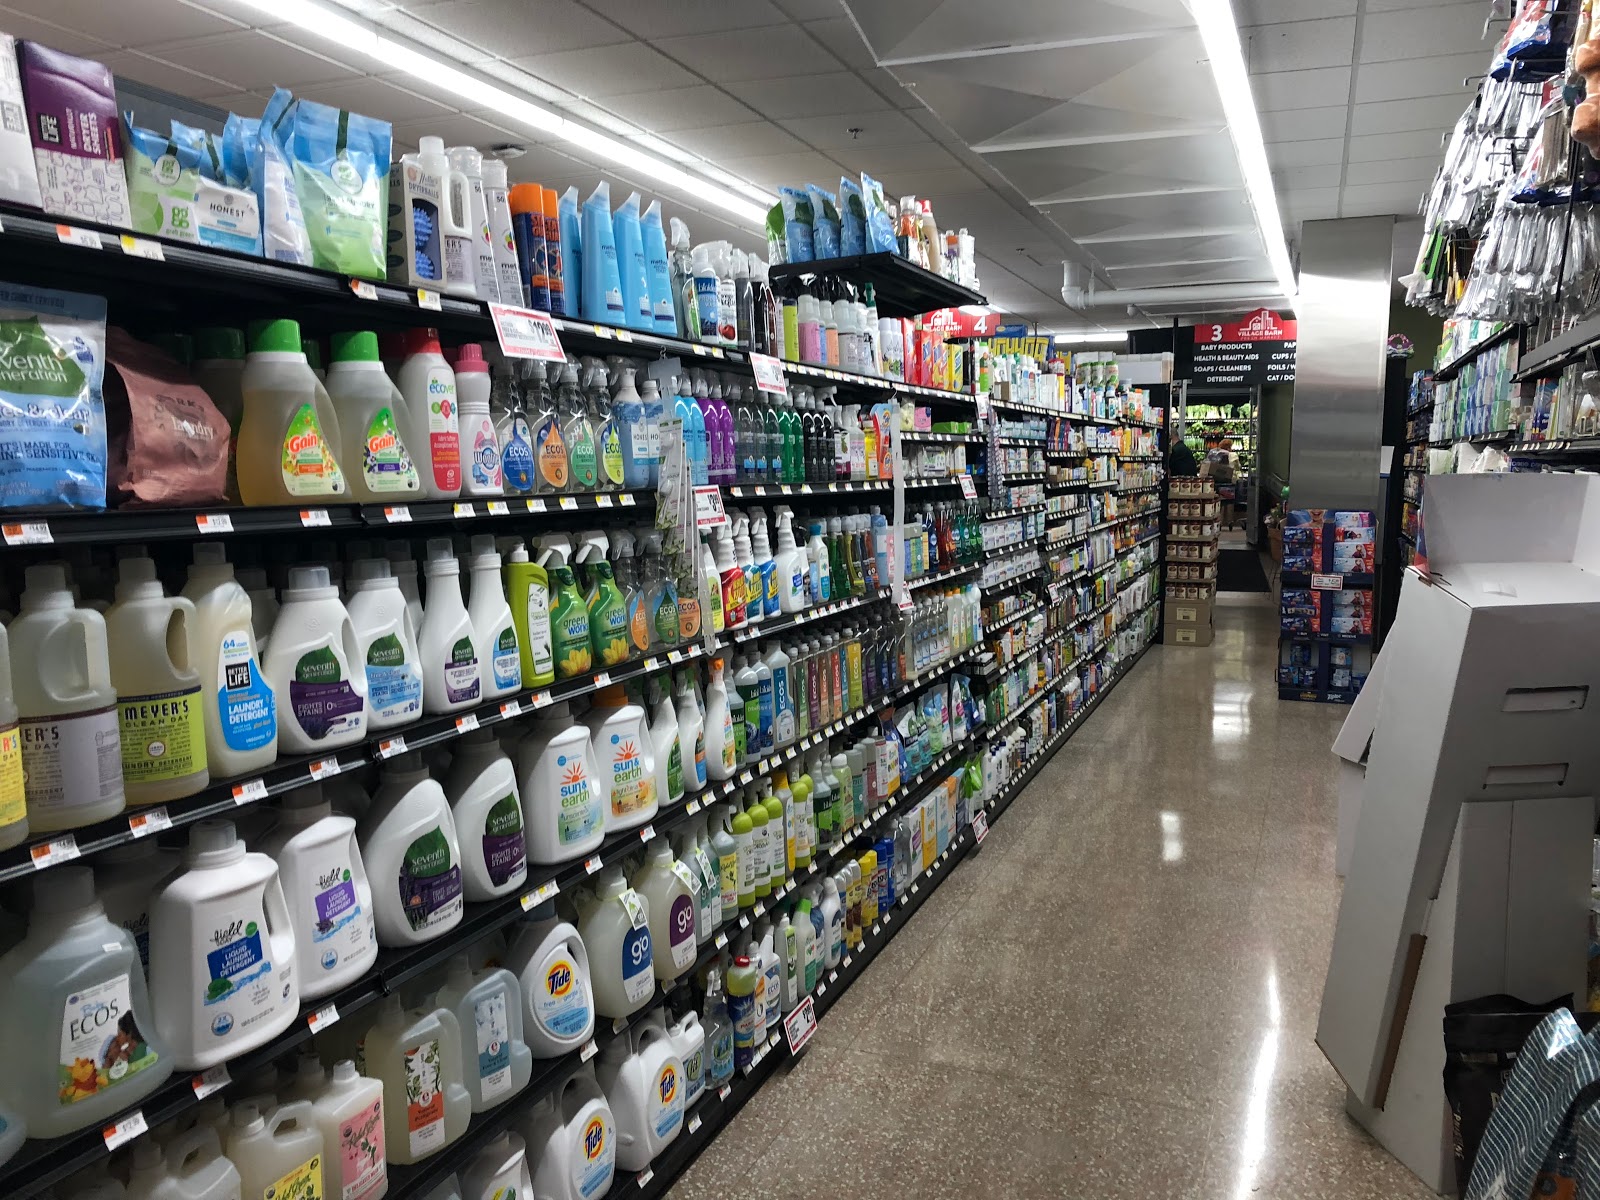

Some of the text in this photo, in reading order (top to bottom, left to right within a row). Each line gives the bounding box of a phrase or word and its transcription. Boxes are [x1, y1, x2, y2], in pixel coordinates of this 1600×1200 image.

[47, 115, 60, 143] LIFE
[80, 113, 92, 152] DRYER
[88, 112, 101, 155] SHEETS
[210, 202, 246, 218] HONEST
[974, 315, 988, 334] 4
[1211, 324, 1223, 342] 3
[1218, 342, 1253, 350] PRODUCTS
[430, 383, 455, 394] ecover
[24, 441, 70, 450] MADE FOR
[289, 433, 318, 453] Gain
[369, 434, 396, 453] Gain
[545, 445, 564, 455] ECOS
[577, 445, 593, 455] ECOS
[509, 446, 529, 457] ECOS
[659, 606, 676, 616] ECOS
[678, 603, 696, 611] ECOS
[563, 616, 586, 628] green
[224, 639, 236, 650] 64
[373, 648, 400, 658] seventh
[373, 655, 401, 664] generation
[227, 666, 248, 676] BETTER
[302, 662, 335, 672] seventh
[302, 670, 335, 679] generation
[229, 673, 249, 687] LIFE
[124, 699, 189, 720] MEYER'S
[228, 699, 264, 715] LAUNDRY
[297, 702, 322, 711] FIGHTS
[298, 708, 323, 718] STAINS
[125, 715, 189, 728] CLEAN DAY
[229, 707, 269, 725] DETERGENT
[20, 726, 60, 743] ER'S
[35, 742, 60, 750] DAY
[122, 760, 155, 770] UNDRY
[613, 758, 640, 773] sun &
[614, 766, 642, 783] earth
[560, 780, 587, 797] sun &
[561, 790, 590, 808] earth
[492, 811, 518, 826] seventh
[411, 848, 445, 865] seventh
[491, 855, 511, 868] STAINS
[411, 857, 446, 874] generation
[315, 867, 341, 888] field
[326, 893, 349, 910] LAUNDRY
[328, 889, 345, 901] LIQUID
[325, 897, 351, 917] DETERGENT
[210, 919, 243, 943] field
[222, 949, 252, 968] LAUNDRY
[225, 945, 247, 960] LIQUID
[220, 954, 255, 977] DETERGENT
[548, 967, 571, 995] Tide
[71, 998, 120, 1042] ECOS
[660, 1074, 675, 1104] Tide
[585, 1125, 603, 1160] Tide
